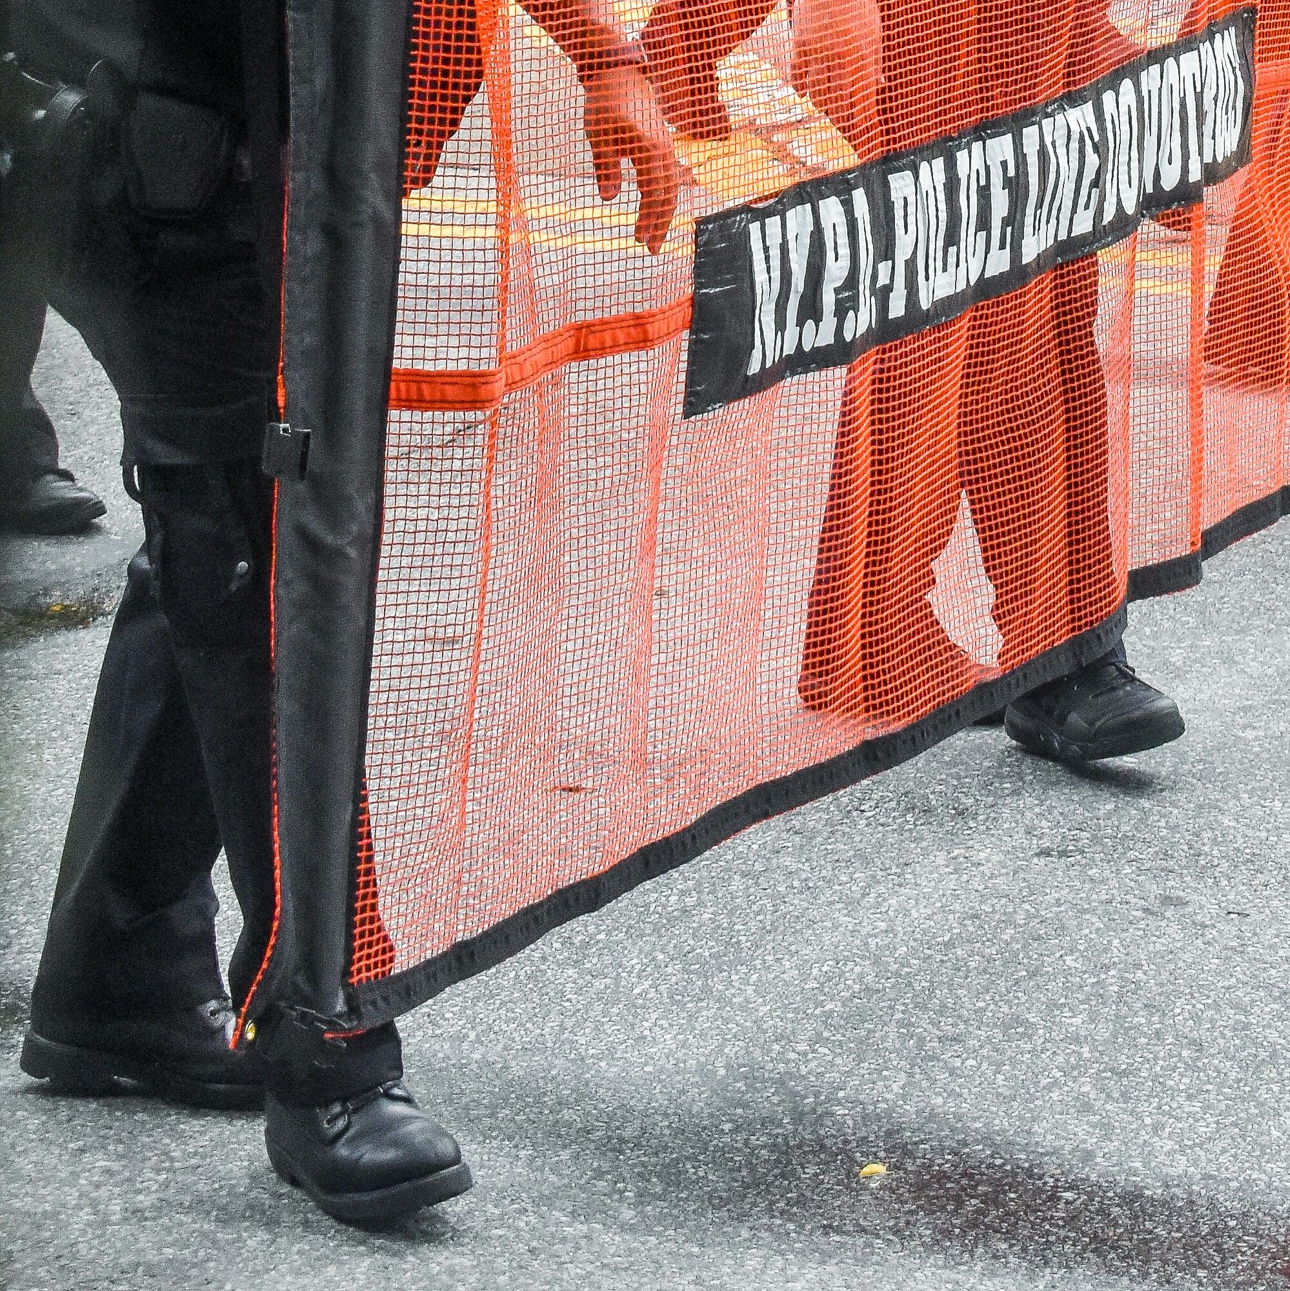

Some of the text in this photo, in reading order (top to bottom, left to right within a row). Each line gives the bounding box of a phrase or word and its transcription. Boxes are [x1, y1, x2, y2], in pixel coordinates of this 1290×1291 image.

[1022, 100, 1100, 265] LINE
[1101, 78, 1139, 226] DO
[1140, 50, 1201, 202] NOT
